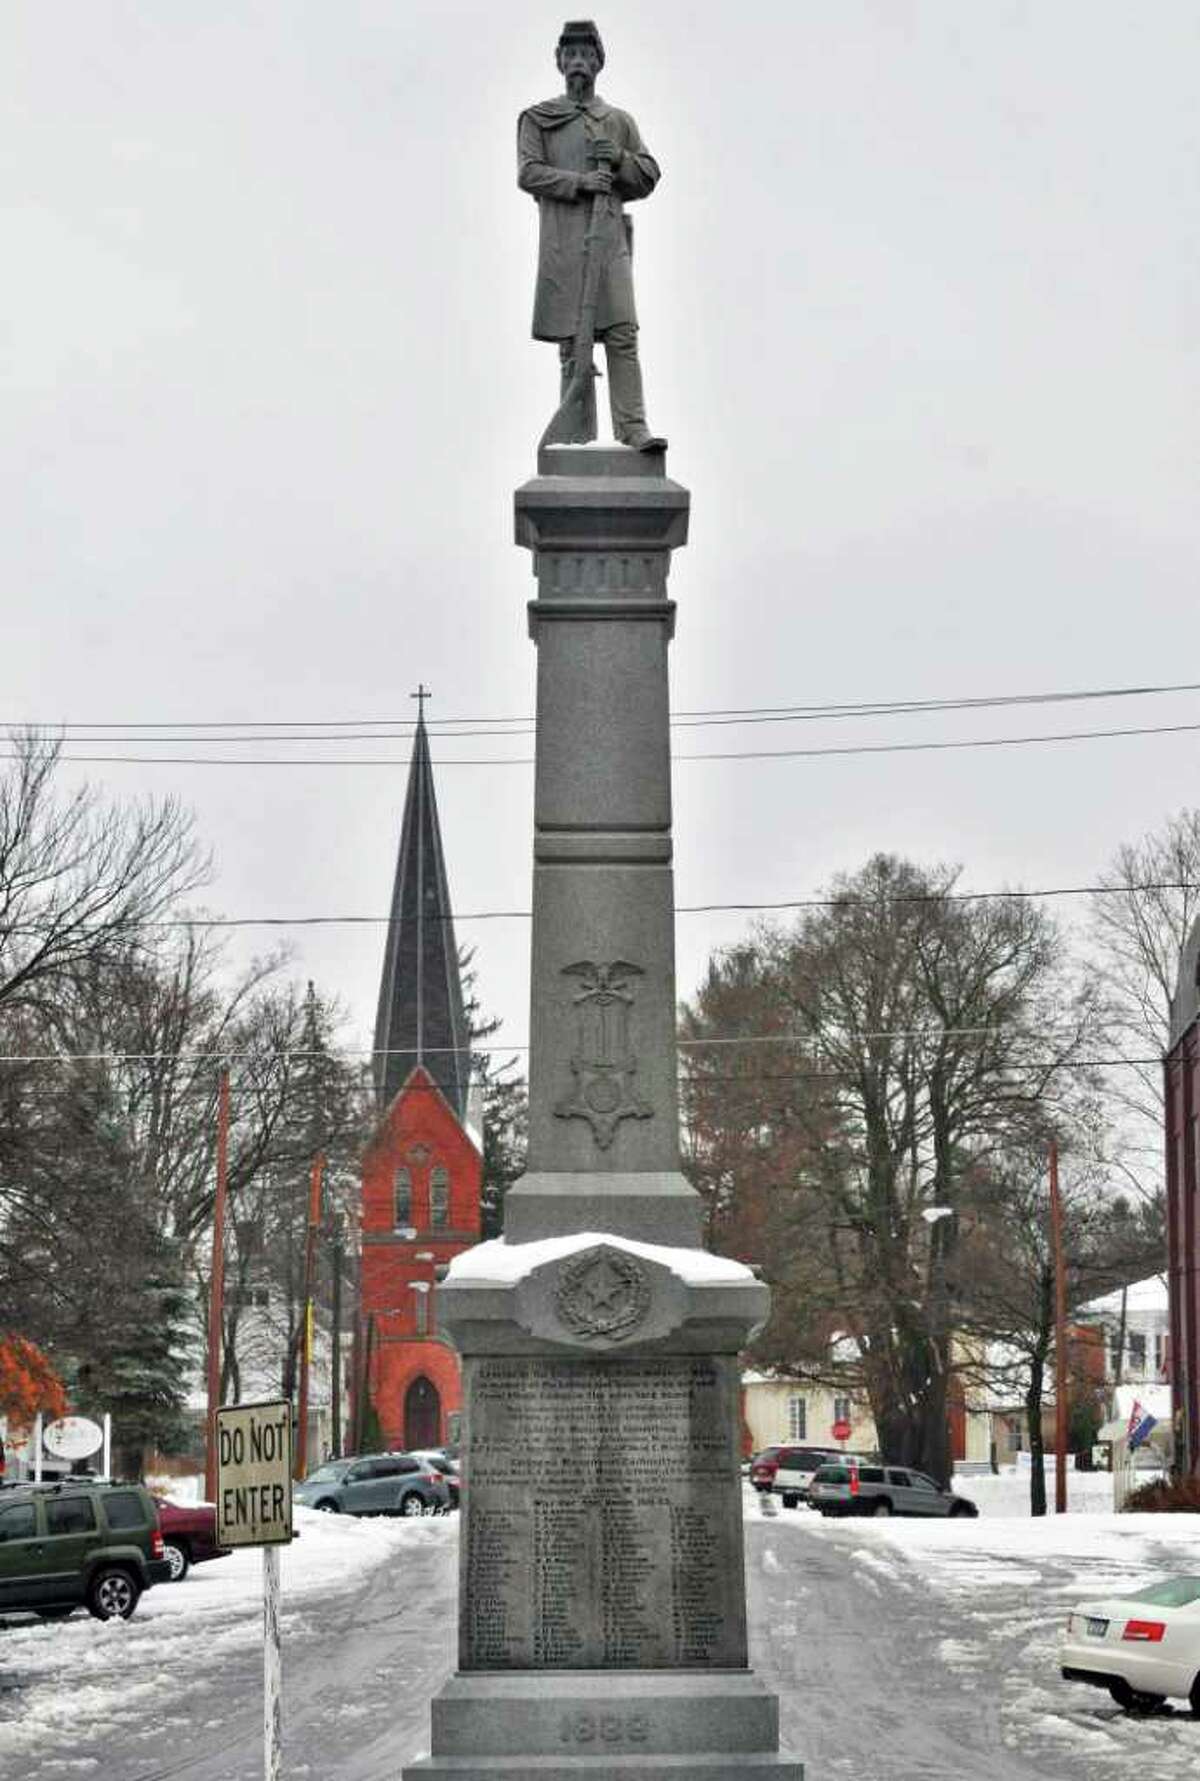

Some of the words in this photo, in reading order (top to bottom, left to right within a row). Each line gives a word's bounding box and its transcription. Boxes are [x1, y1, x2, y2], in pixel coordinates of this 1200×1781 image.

[220, 1428, 245, 1467] DO
[250, 1422, 286, 1463] NOT
[223, 1484, 285, 1527] ENTER
